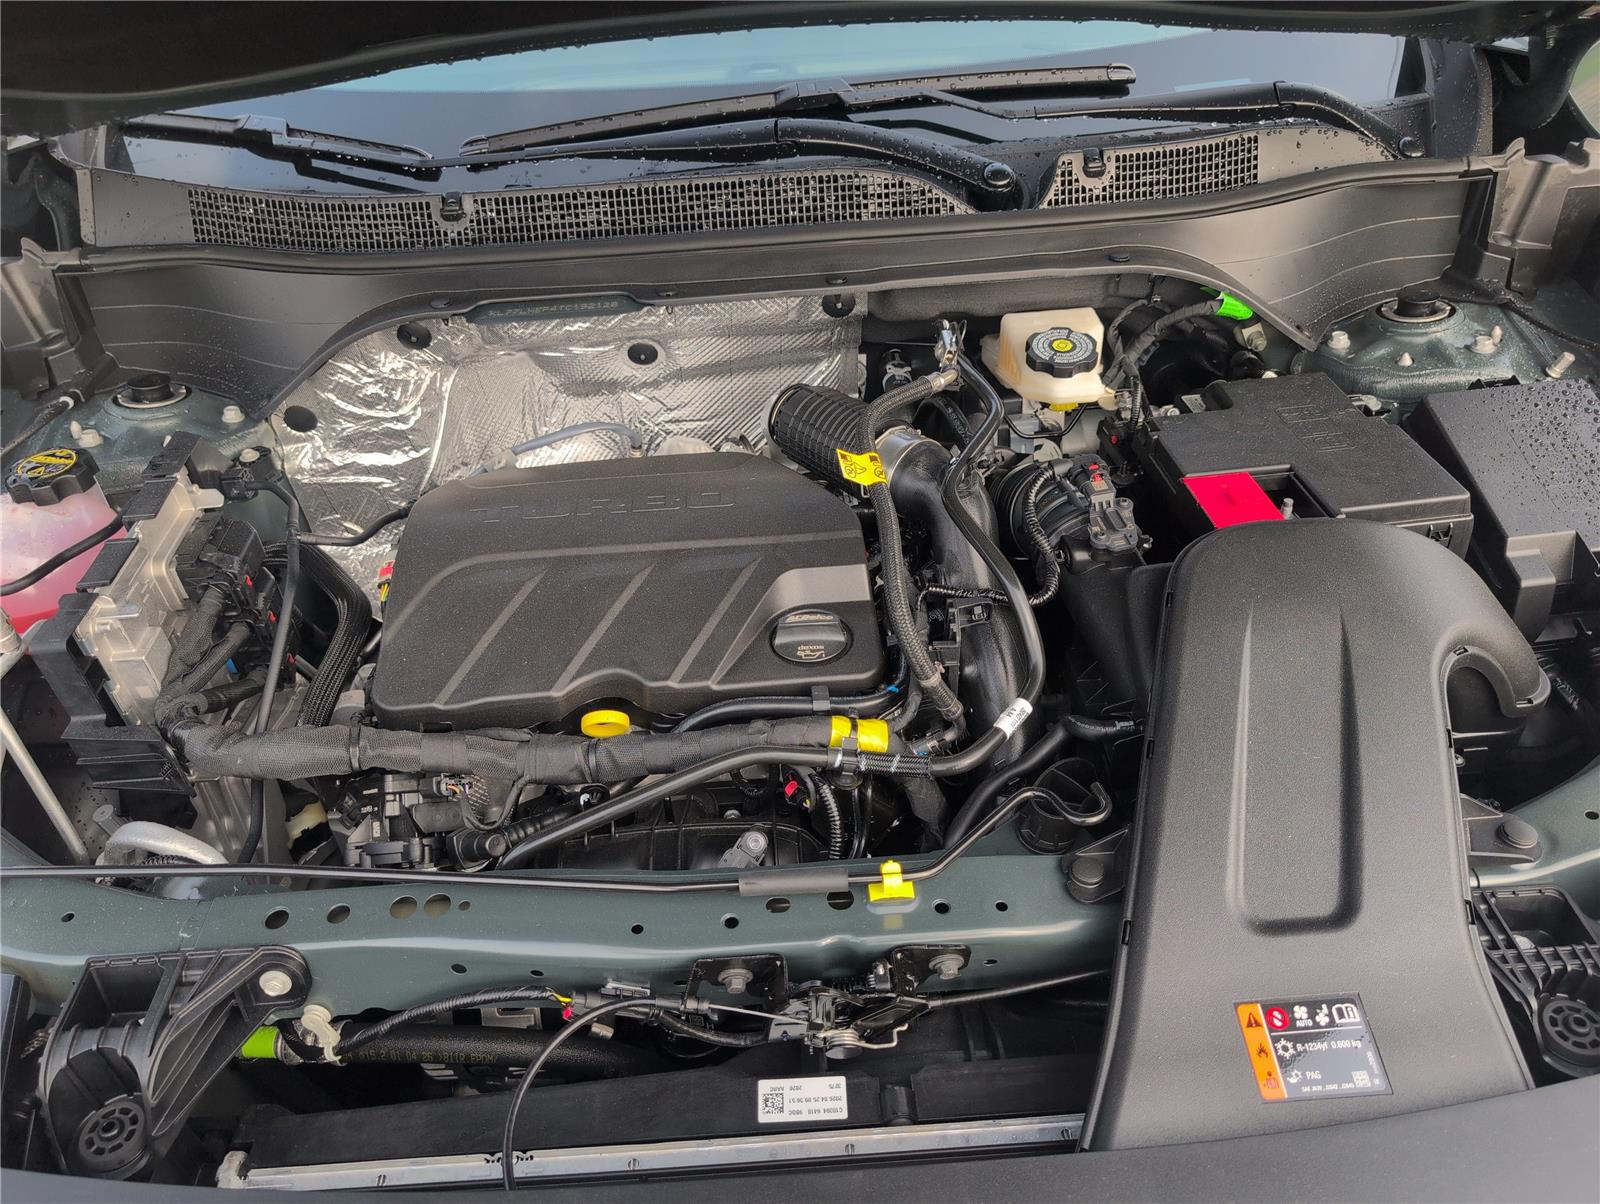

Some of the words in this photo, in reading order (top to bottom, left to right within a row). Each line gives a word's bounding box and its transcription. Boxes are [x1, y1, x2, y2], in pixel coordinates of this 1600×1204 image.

[1296, 1019, 1313, 1027] AUTO
[1296, 1041, 1328, 1052] R-1234yf
[1306, 1071, 1321, 1080] PAG
